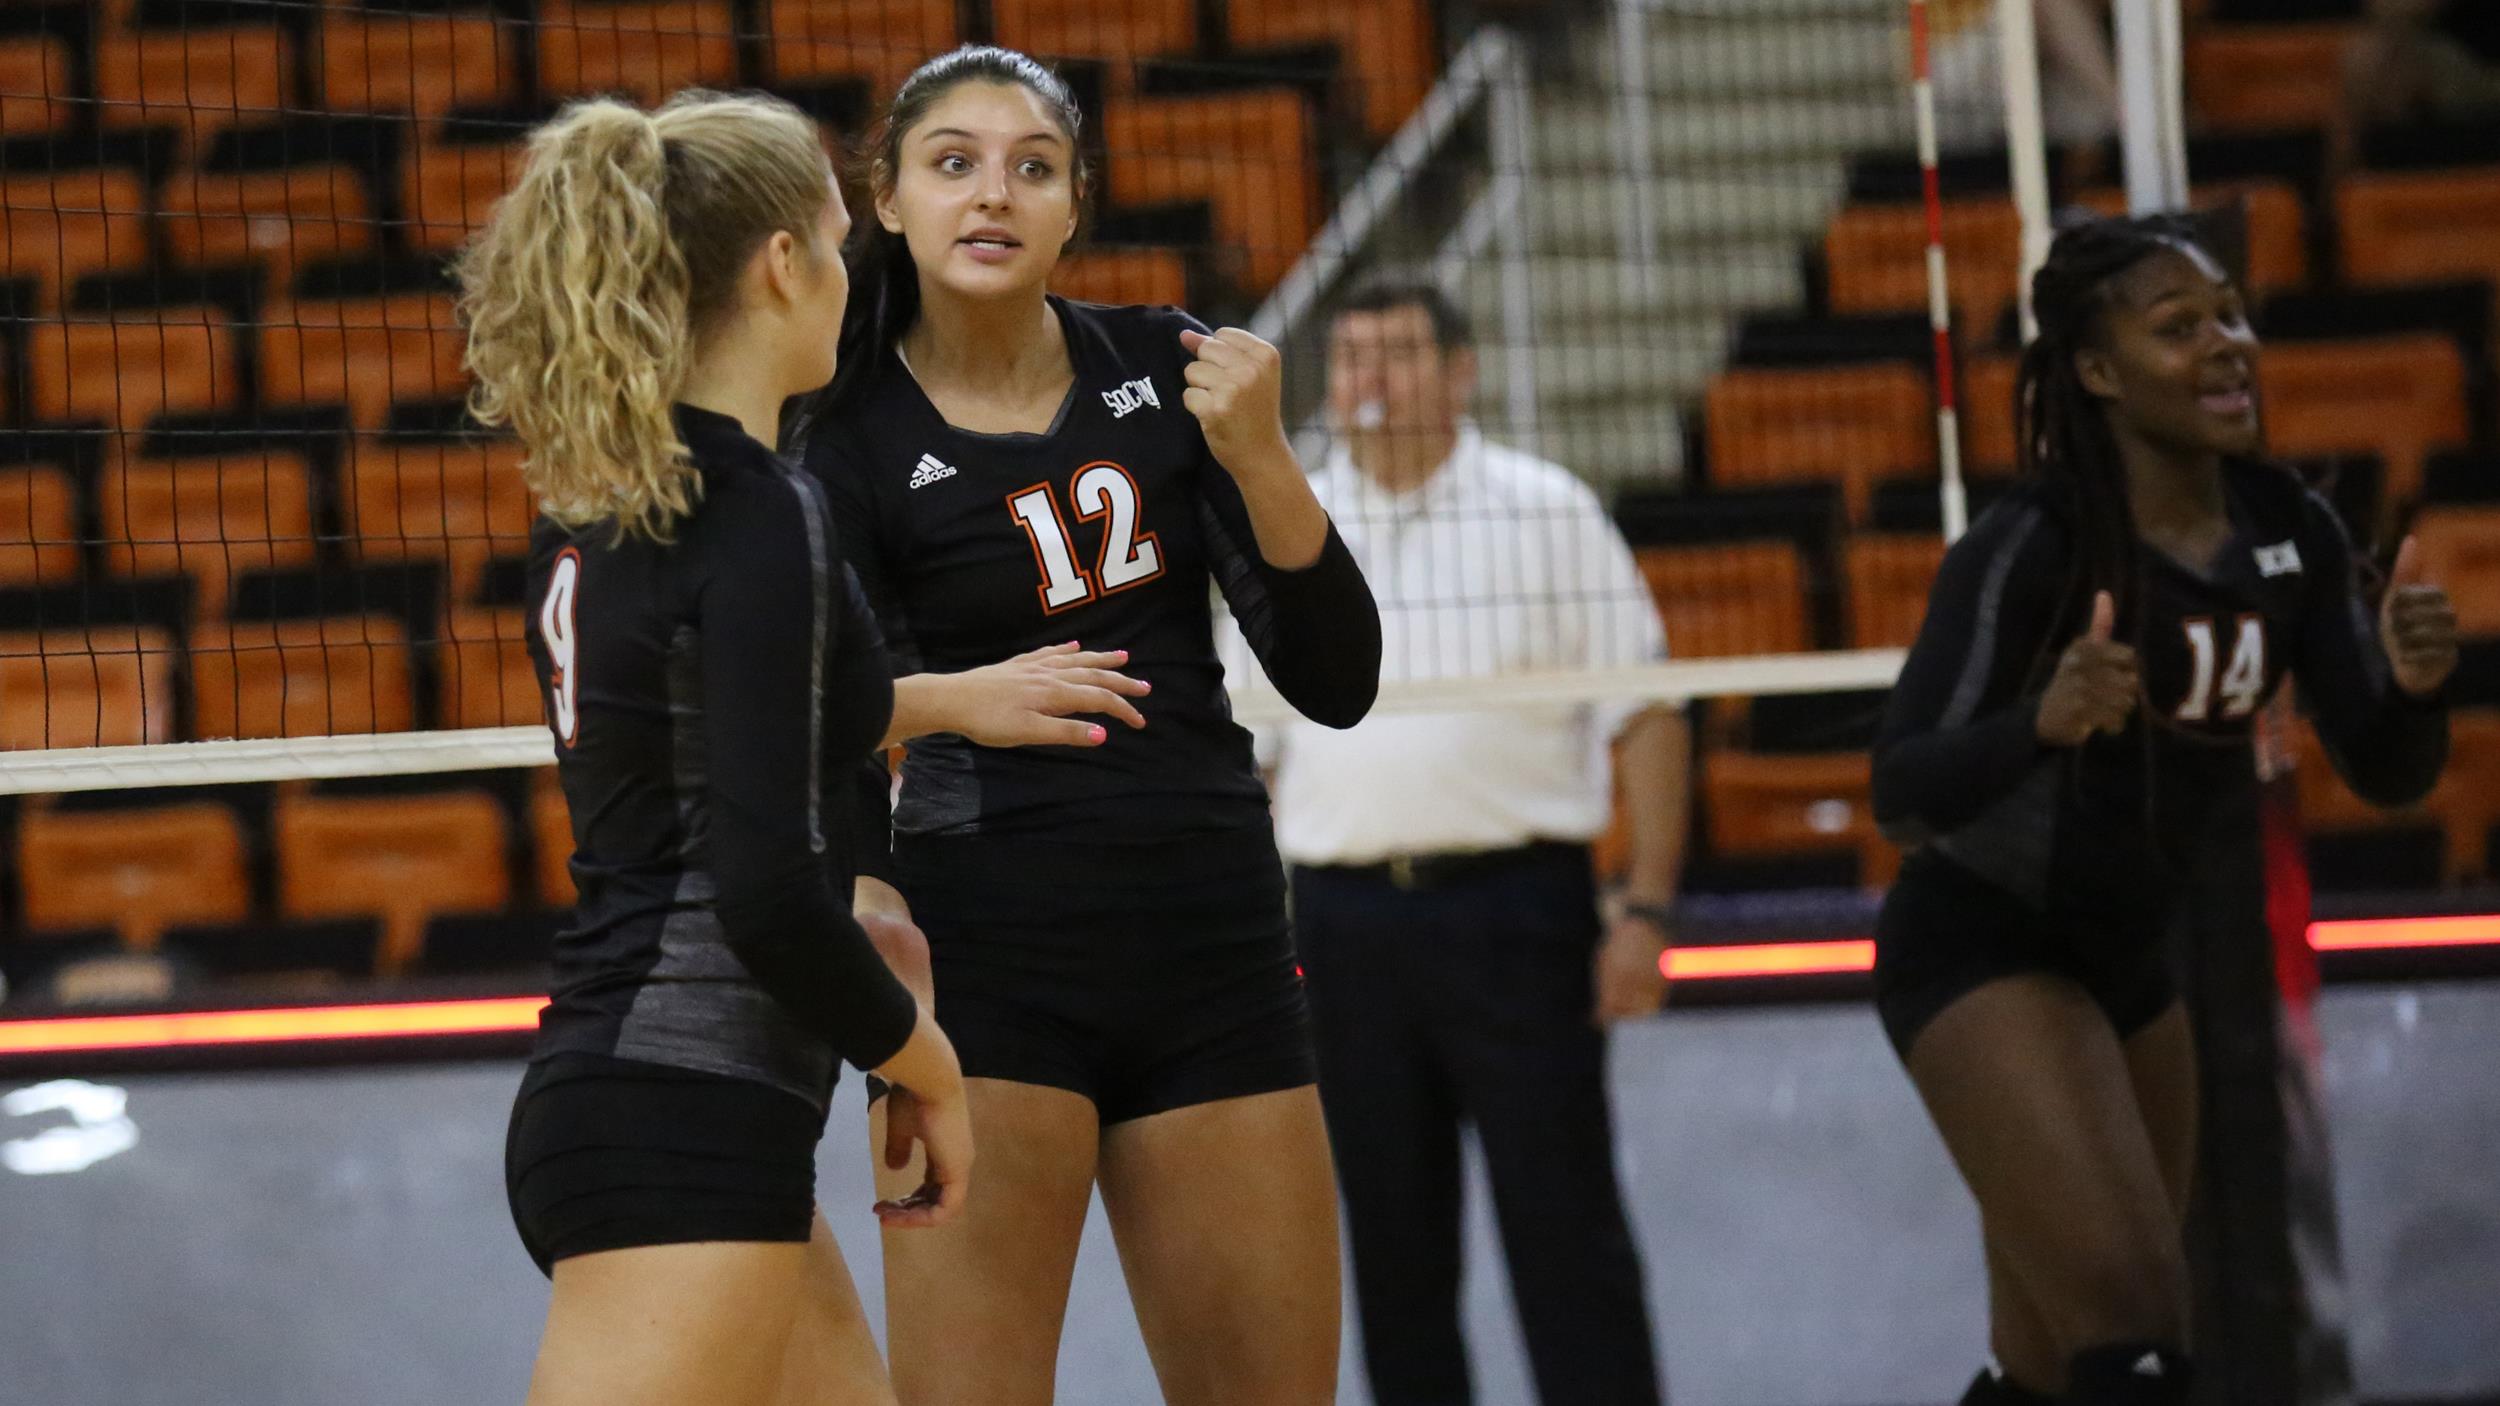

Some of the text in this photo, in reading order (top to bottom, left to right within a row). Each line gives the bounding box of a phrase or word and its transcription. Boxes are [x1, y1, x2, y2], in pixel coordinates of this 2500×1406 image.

[910, 466, 957, 489] adidas
[1007, 461, 1166, 616] 12
[539, 546, 581, 748] 9
[2175, 614, 2265, 721] 14
